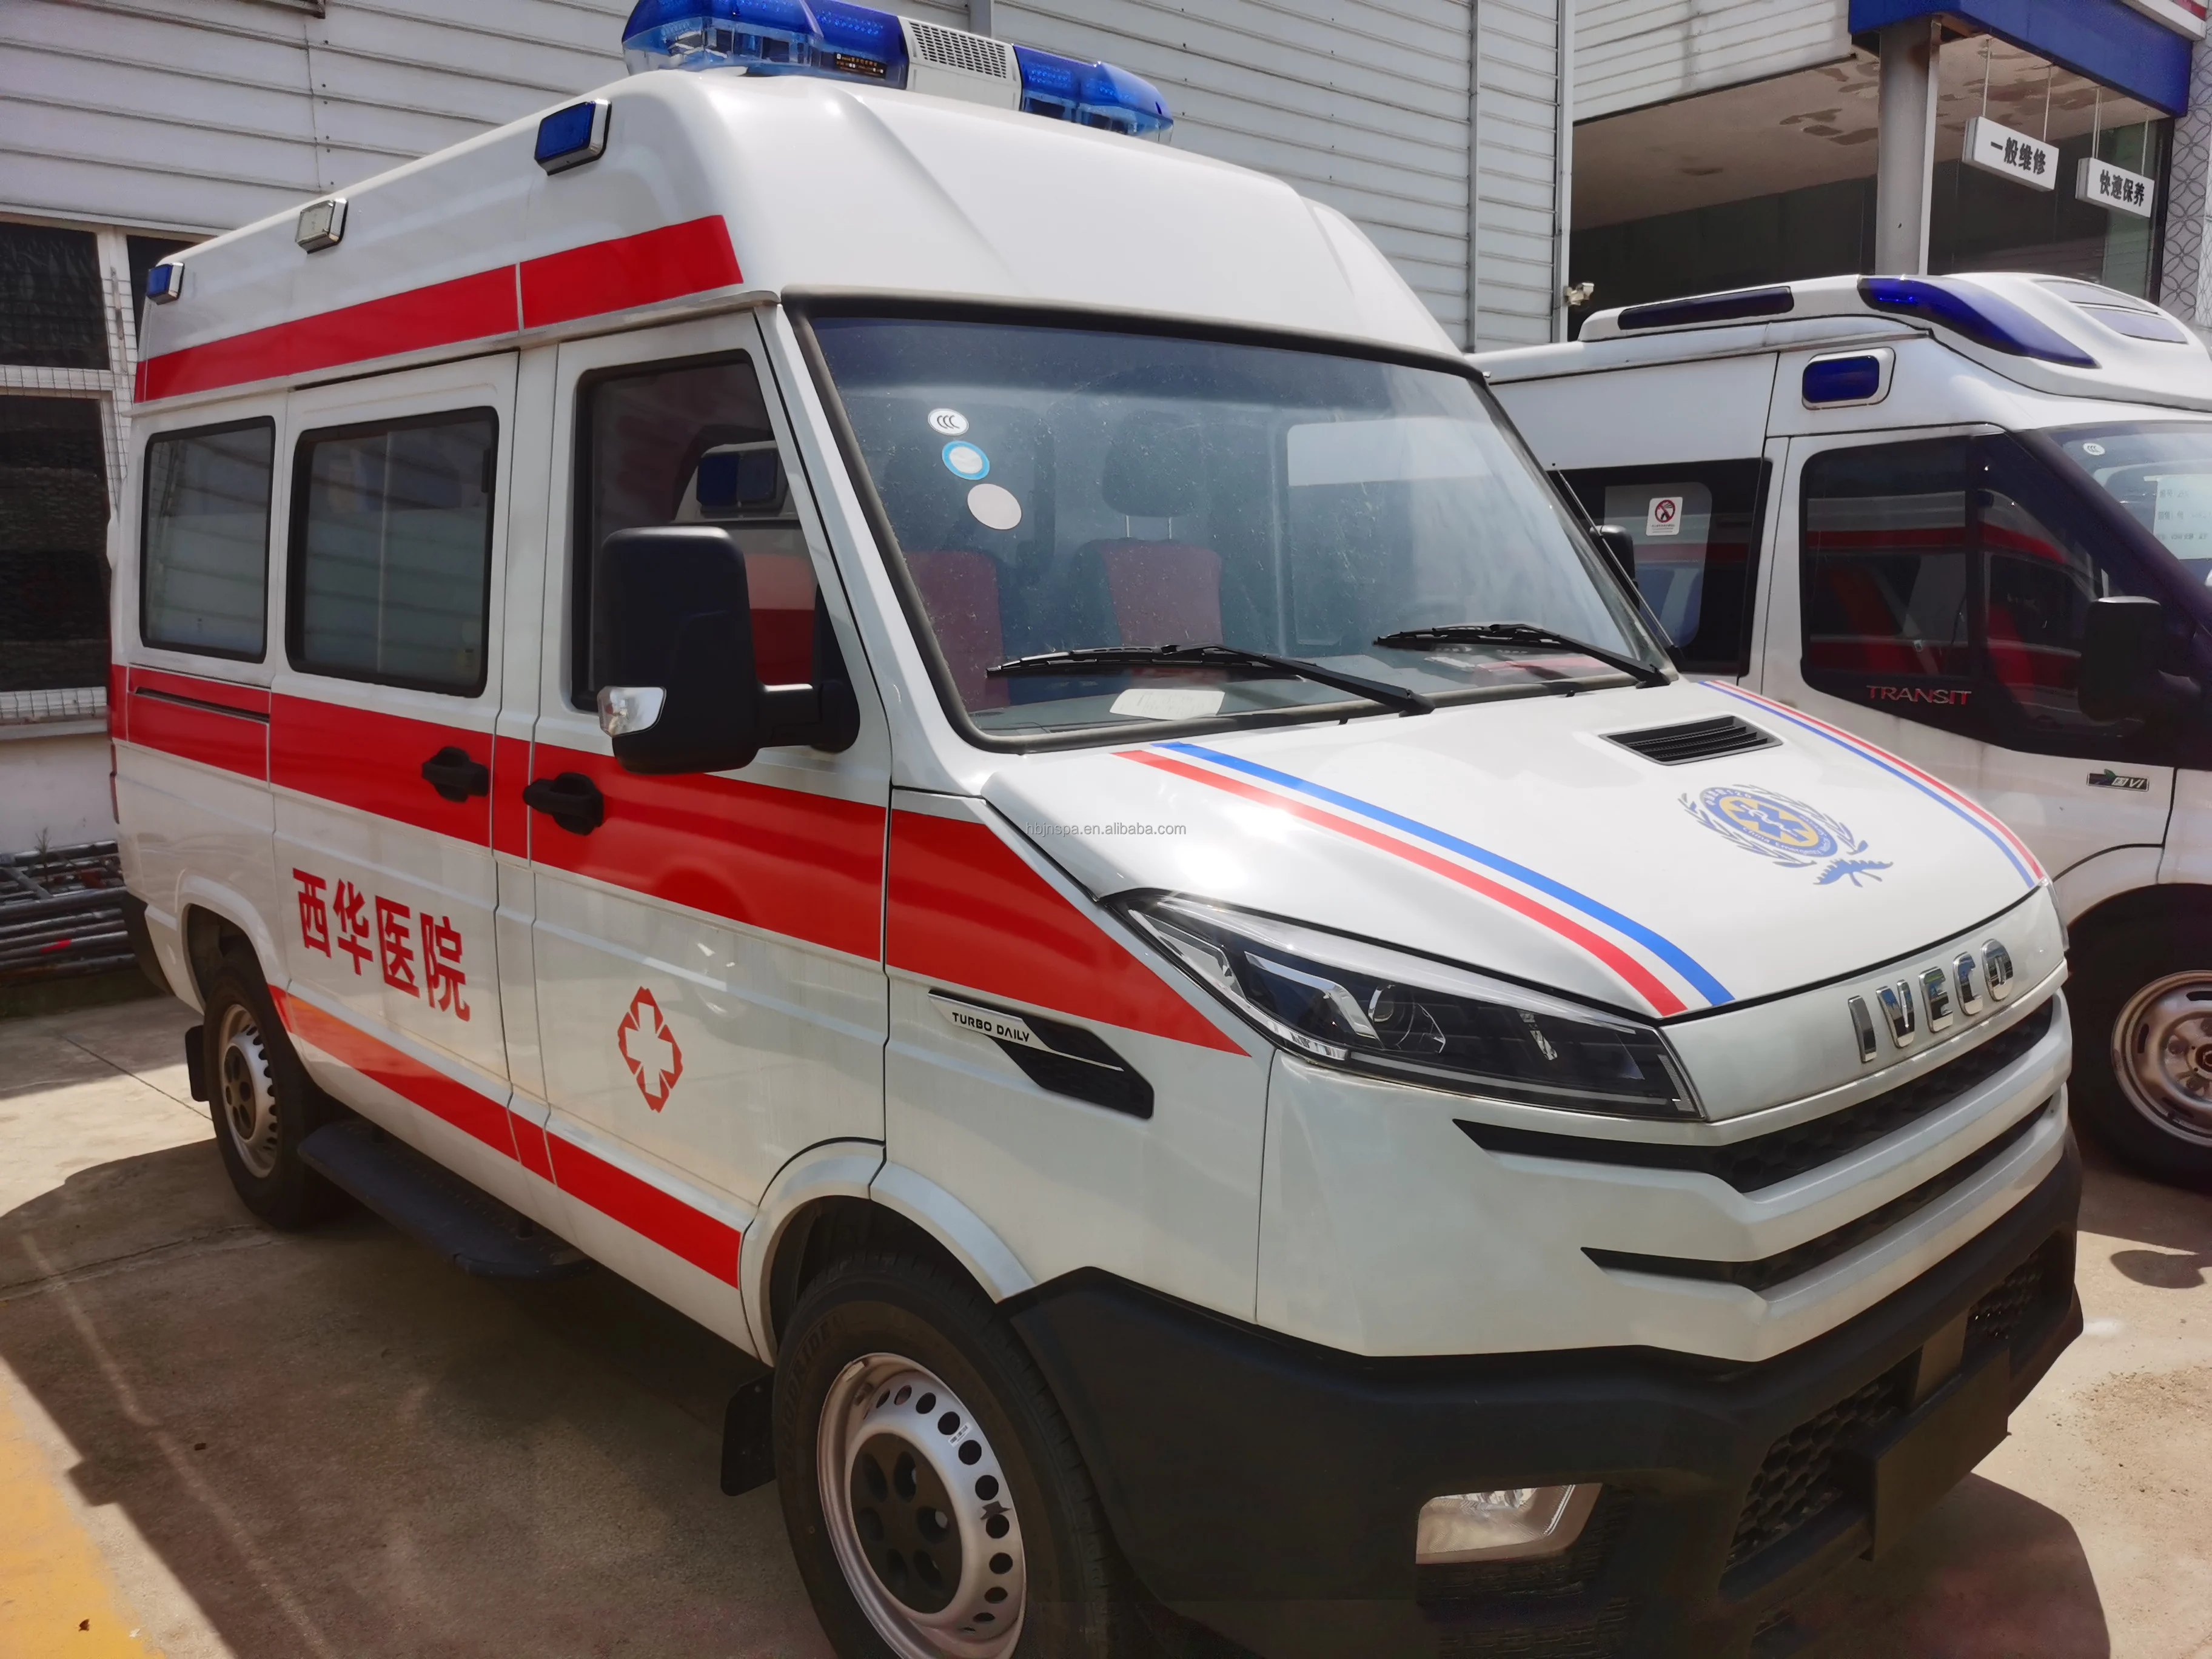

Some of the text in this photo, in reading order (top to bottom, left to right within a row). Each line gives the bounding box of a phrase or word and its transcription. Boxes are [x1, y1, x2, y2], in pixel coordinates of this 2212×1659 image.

[1990, 136, 2047, 175] 一般维修
[2099, 169, 2145, 207] 快速保养
[1865, 685, 1972, 706] TRANSIT
[292, 867, 471, 1022] 西华医院
[1848, 938, 2014, 1063] IVECO
[952, 1011, 1030, 1042] TURBO DAILY
